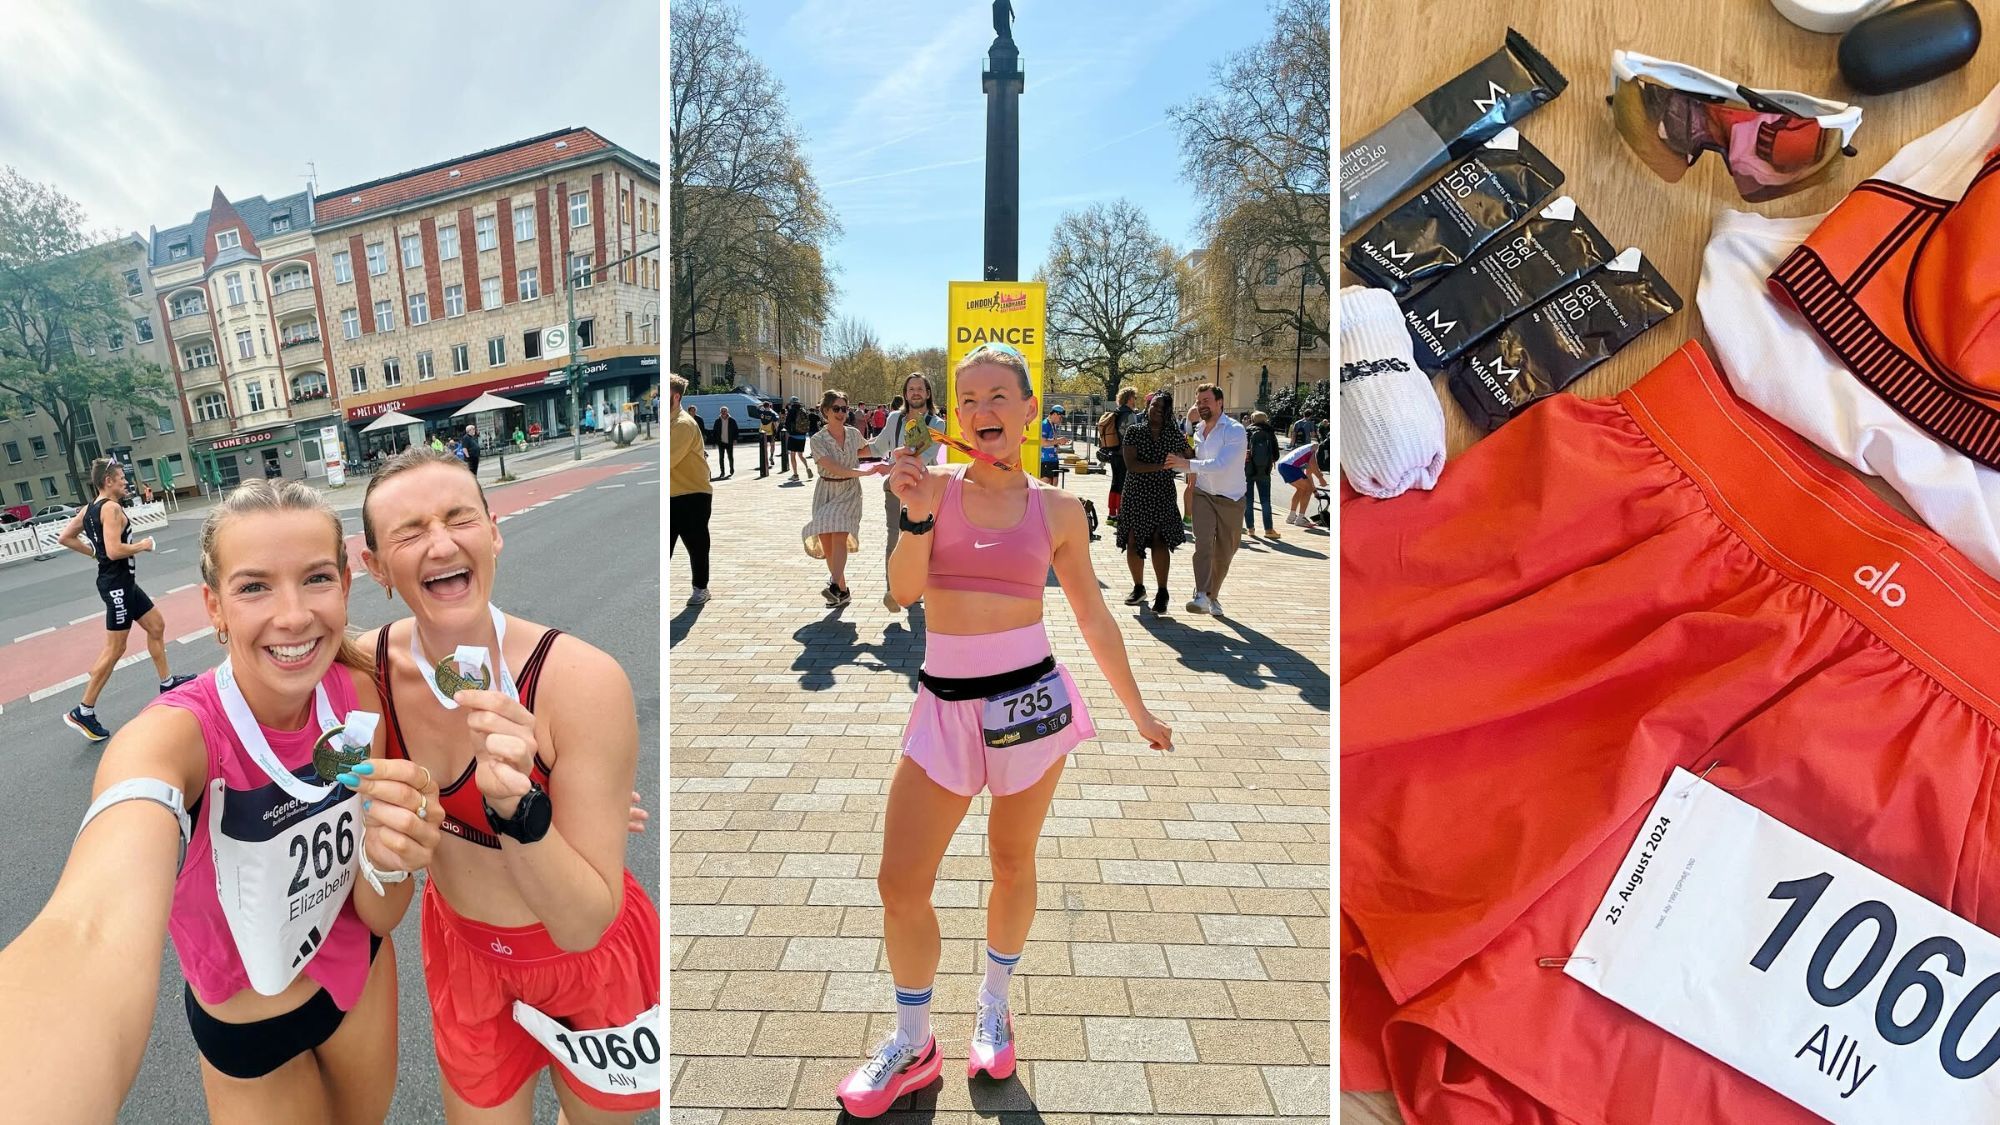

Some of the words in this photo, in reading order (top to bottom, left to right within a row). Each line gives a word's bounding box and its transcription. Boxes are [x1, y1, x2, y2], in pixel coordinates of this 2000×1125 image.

[1360, 156, 1369, 167] C
[1368, 145, 1387, 163] 160
[1444, 169, 1472, 199] 100
[1460, 159, 1483, 190] Gel
[1490, 175, 1507, 194] Sports
[1361, 242, 1408, 280] MAURTEN
[1494, 245, 1522, 270] 100
[1511, 236, 1537, 262] Gel
[1541, 249, 1556, 266] Sports
[1553, 263, 1565, 276] Fuel
[967, 298, 993, 309] LONDON
[1558, 292, 1586, 321] 100
[1575, 283, 1601, 312] Gel
[1589, 278, 1608, 300] Hydrogel
[1604, 298, 1620, 316] Sports
[1616, 314, 1629, 328] Fuel
[957, 327, 1035, 344] DANCE
[1405, 310, 1445, 357] MAURTEN
[1470, 356, 1511, 406] MAURTEN
[356, 406, 371, 417] PRET
[213, 438, 241, 449] BLUME
[246, 433, 272, 444] 2000
[1854, 561, 1906, 607] alo
[109, 588, 128, 625] Berlin
[1003, 686, 1053, 722] 735
[441, 820, 461, 833] alo
[287, 811, 354, 898] 266
[1605, 904, 1626, 926] 25.
[1619, 850, 1654, 903] August
[1645, 816, 1672, 853] 2024
[289, 868, 351, 922] Elizabeth
[490, 937, 512, 955] alo
[1749, 871, 2000, 1080] 1060
[556, 1026, 660, 1071] 1060
[1795, 1023, 1877, 1099] Ally
[608, 1073, 637, 1089] Ally
